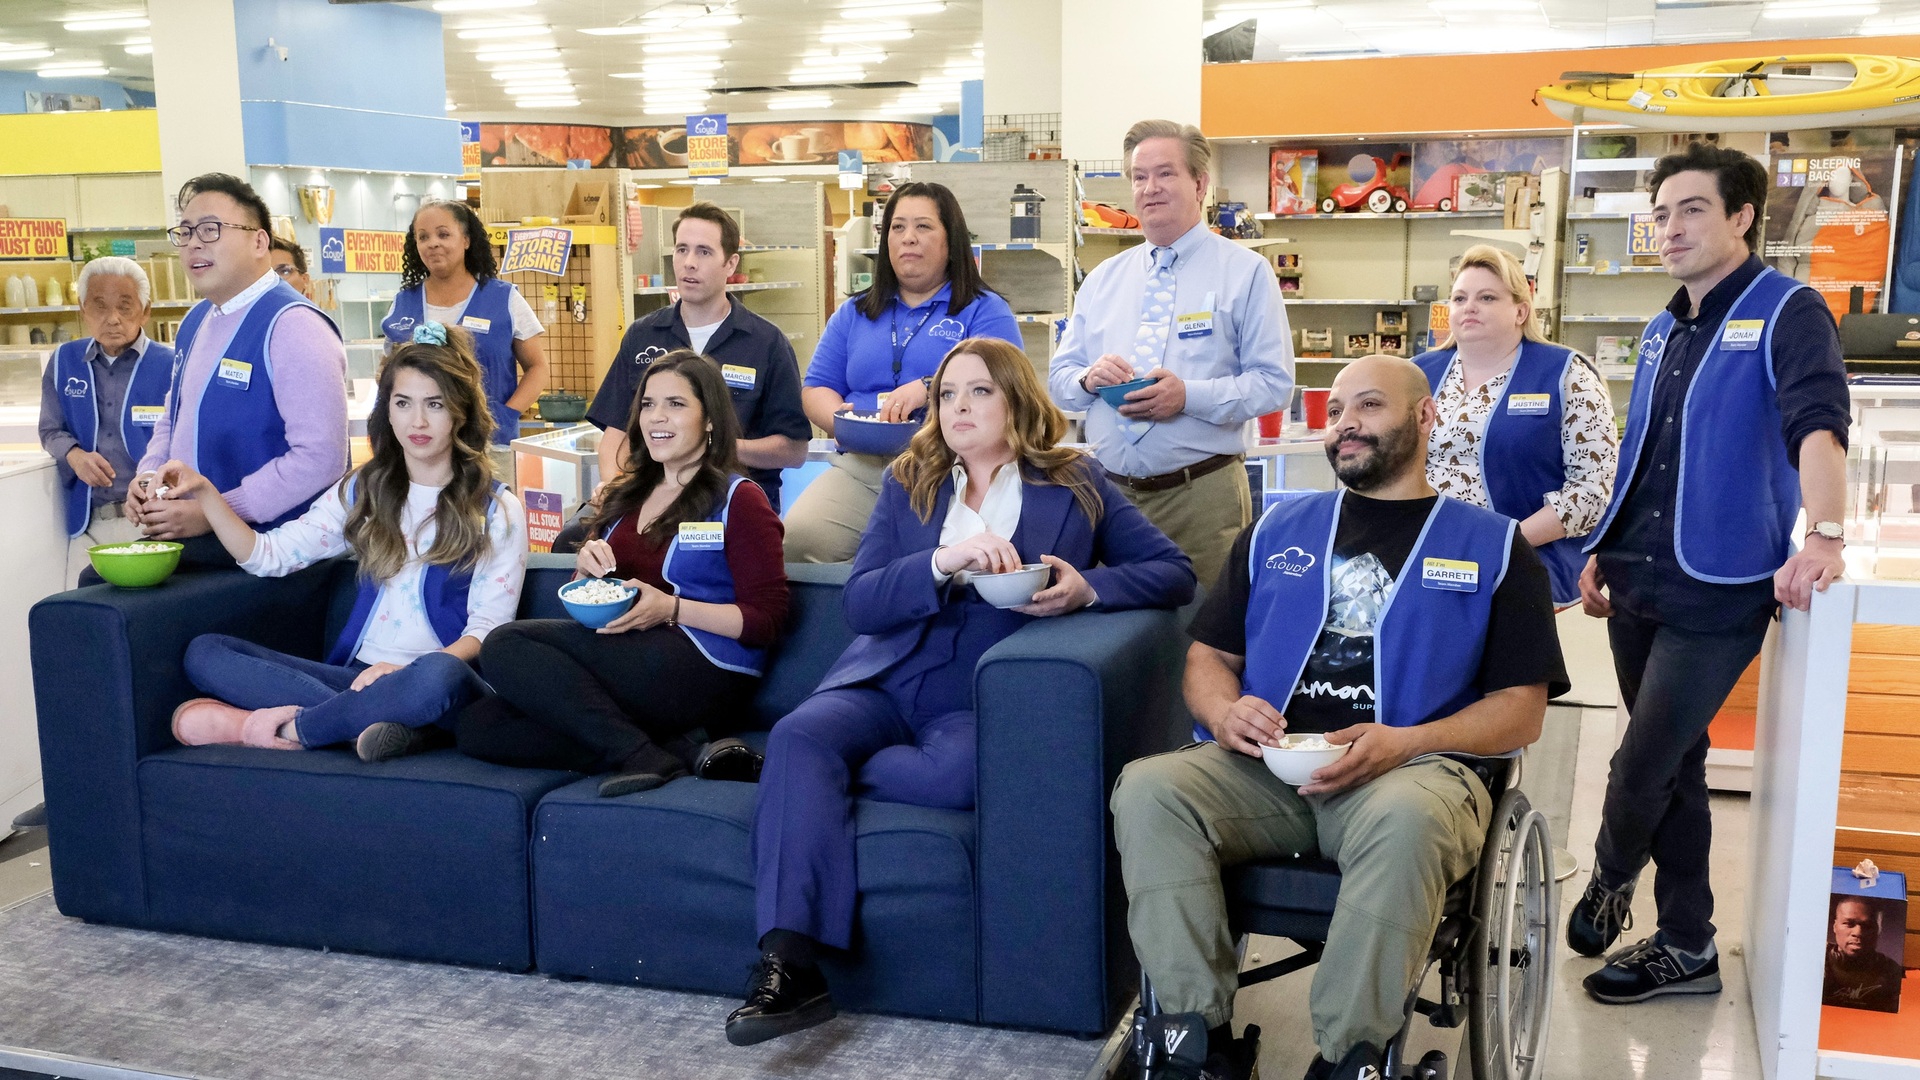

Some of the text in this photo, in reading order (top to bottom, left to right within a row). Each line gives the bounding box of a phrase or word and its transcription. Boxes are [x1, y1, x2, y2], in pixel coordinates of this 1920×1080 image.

[689, 137, 727, 149] STORE
[689, 148, 727, 160] CLOSING
[1809, 158, 1861, 170] SLEEPING
[35, 238, 58, 255] GO!
[346, 232, 404, 253] EVERYTHING
[509, 237, 567, 257] STORE
[354, 253, 400, 272] MUST GO!
[505, 252, 562, 273] CLOSING
[1184, 322, 1206, 330] GLENN
[929, 329, 963, 338] CLOUD9
[225, 369, 244, 379] MATEO
[724, 372, 752, 381] MARCUS
[529, 512, 561, 529] ALL STOCK
[680, 533, 722, 541] VANGELINE
[1265, 560, 1309, 574] CLOUD9
[1426, 569, 1474, 581] GARRETT
